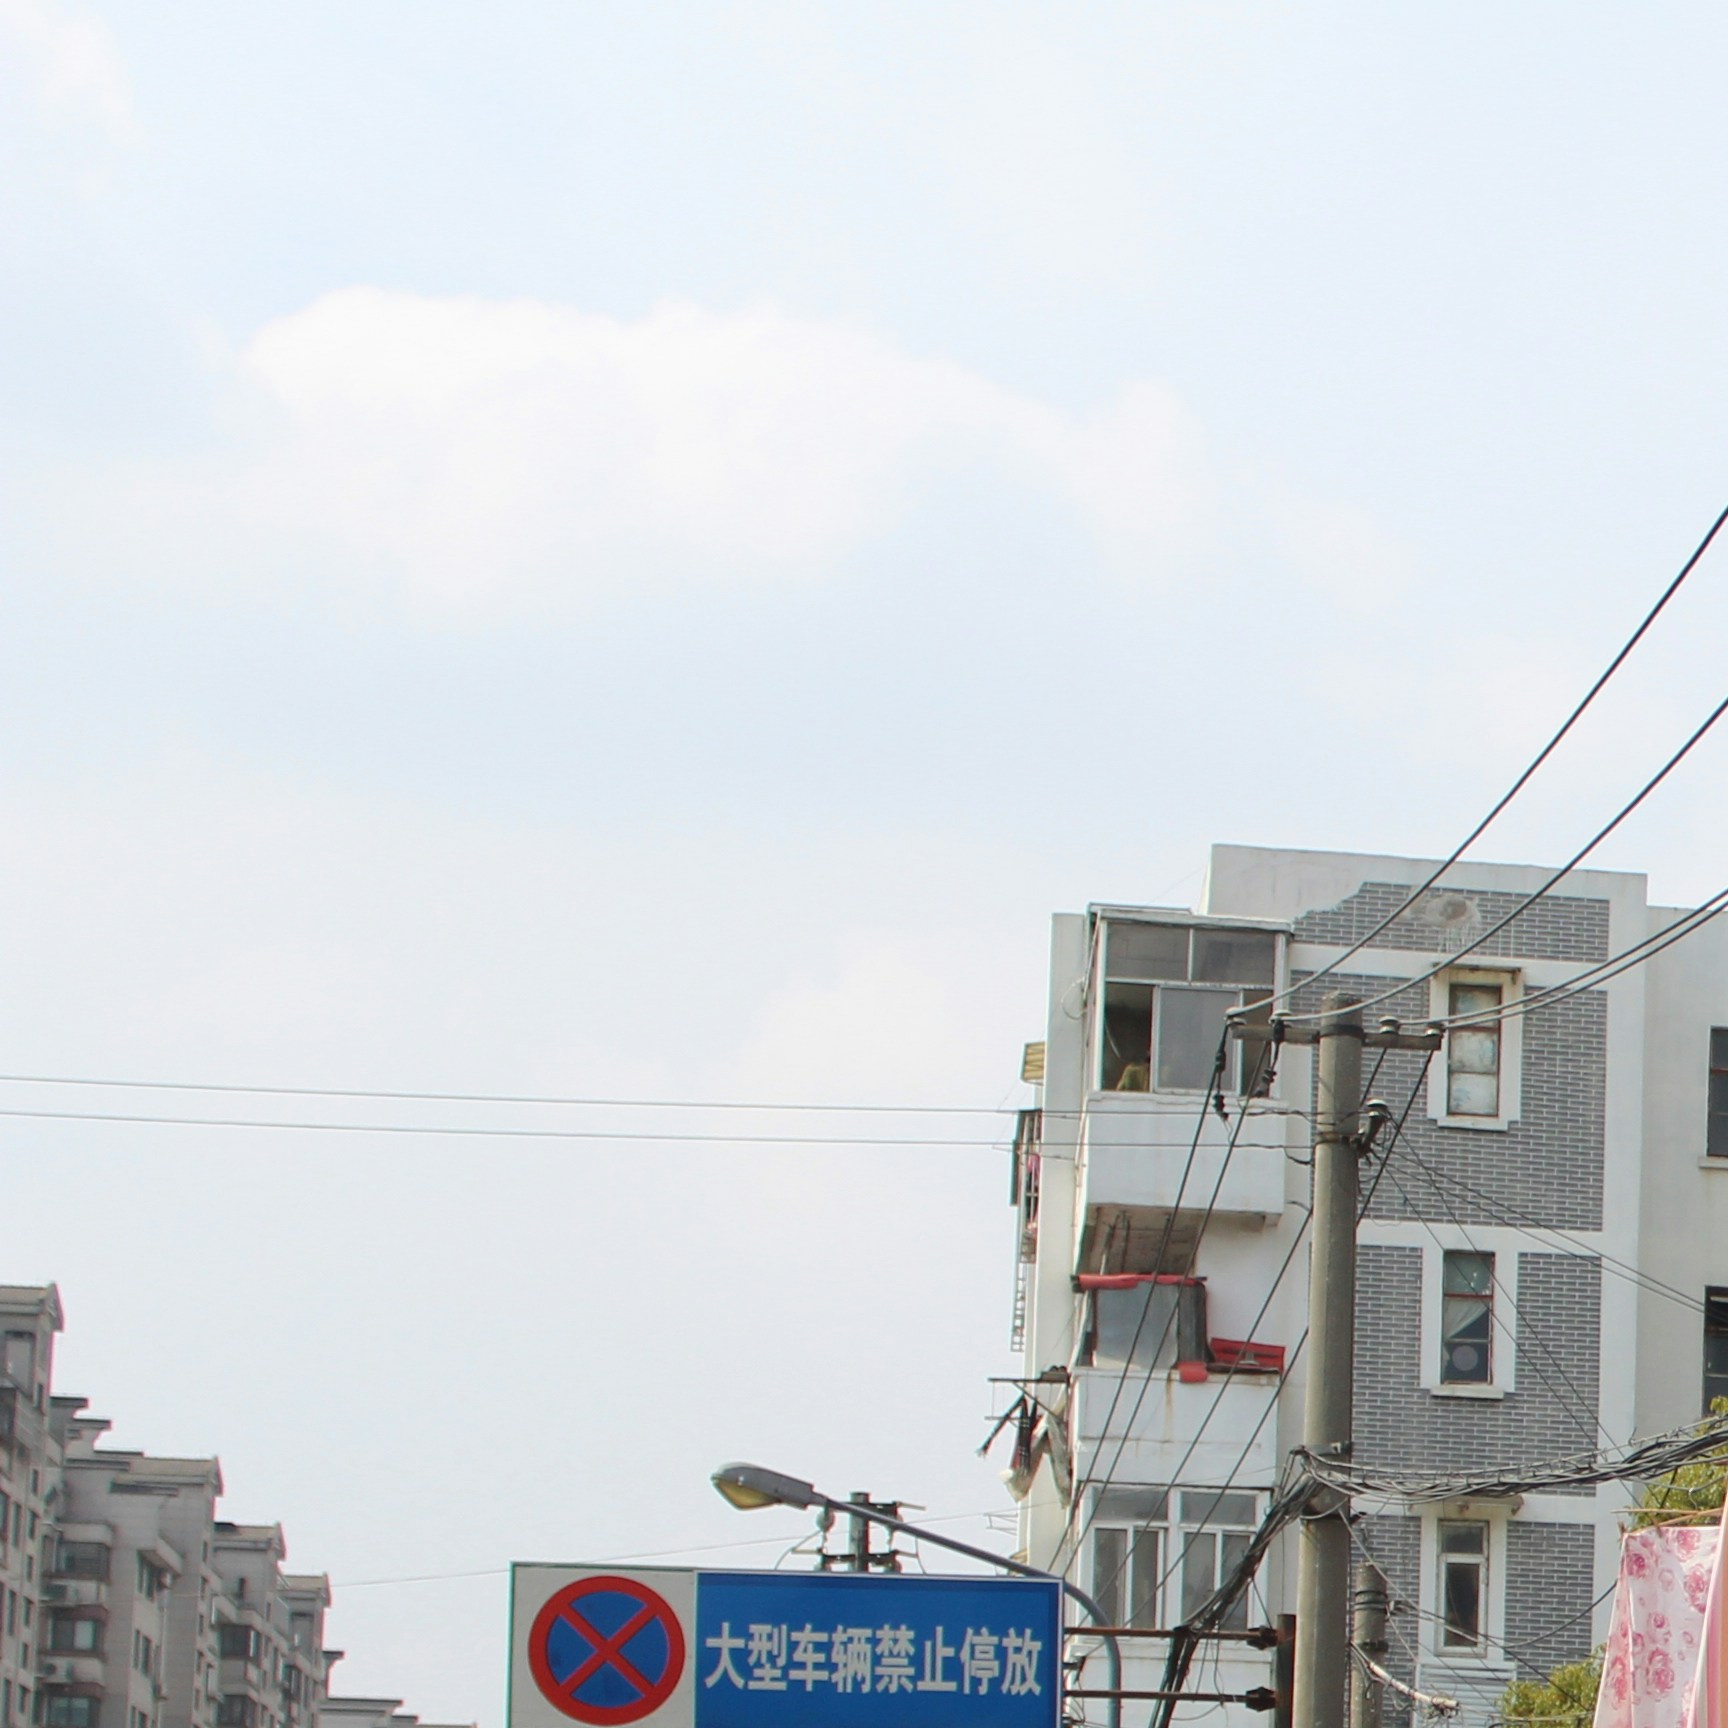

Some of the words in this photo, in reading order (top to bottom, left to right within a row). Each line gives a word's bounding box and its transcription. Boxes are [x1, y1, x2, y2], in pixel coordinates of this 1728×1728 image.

[704, 1622, 1043, 1697] 大型车辆禁止停放
